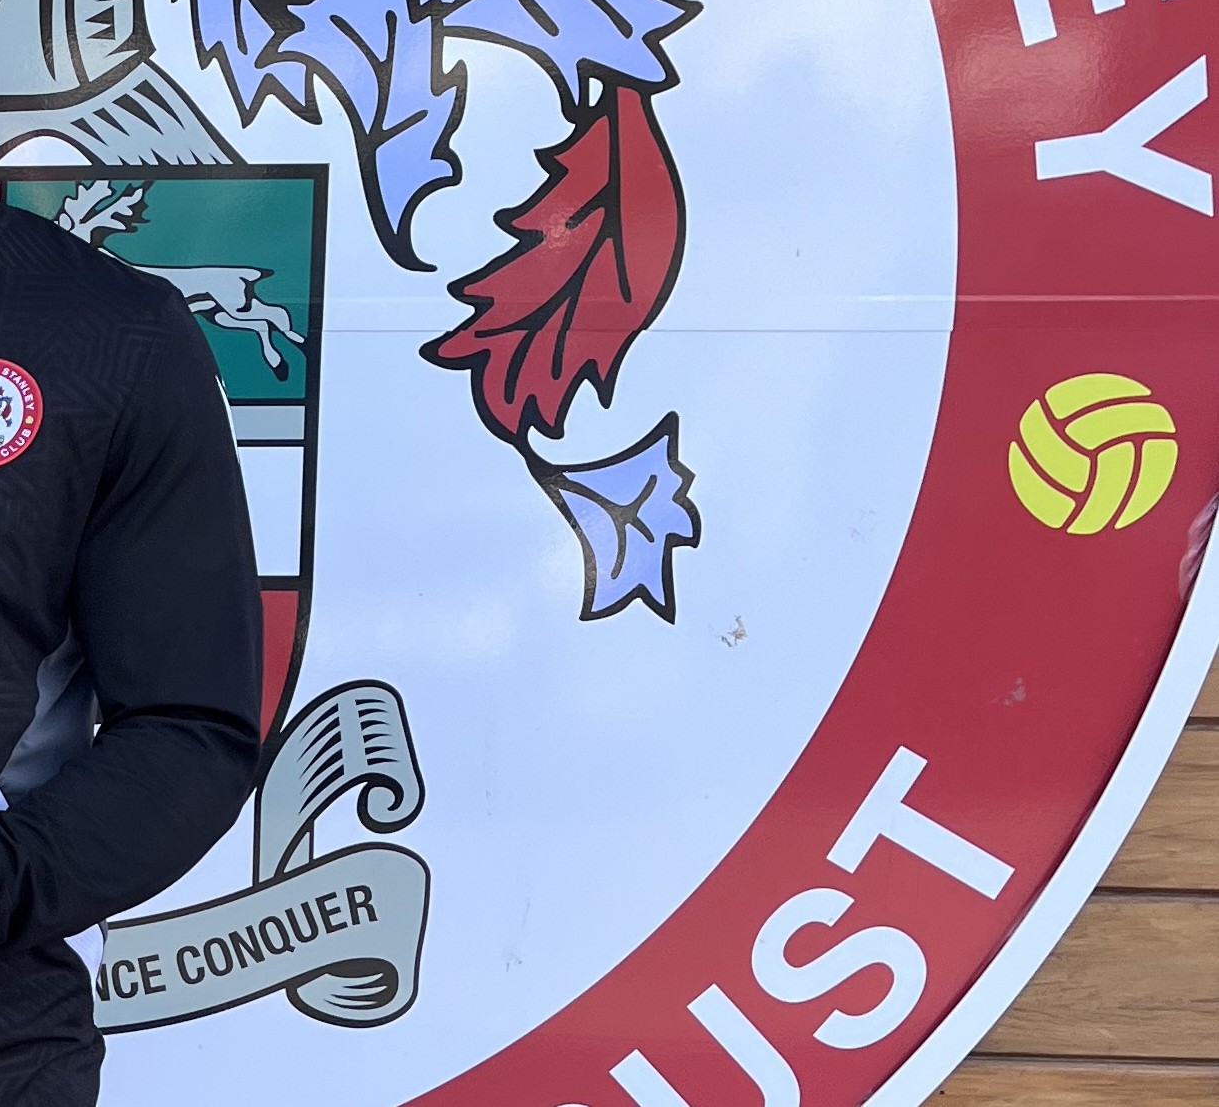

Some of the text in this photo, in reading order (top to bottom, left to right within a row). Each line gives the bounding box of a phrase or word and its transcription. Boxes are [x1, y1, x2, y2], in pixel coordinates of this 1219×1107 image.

[1, 367, 35, 411] STANLEY
[0, 428, 32, 457] CLUB
[176, 884, 379, 985] CONQUER
[553, 745, 1016, 1107] UST
